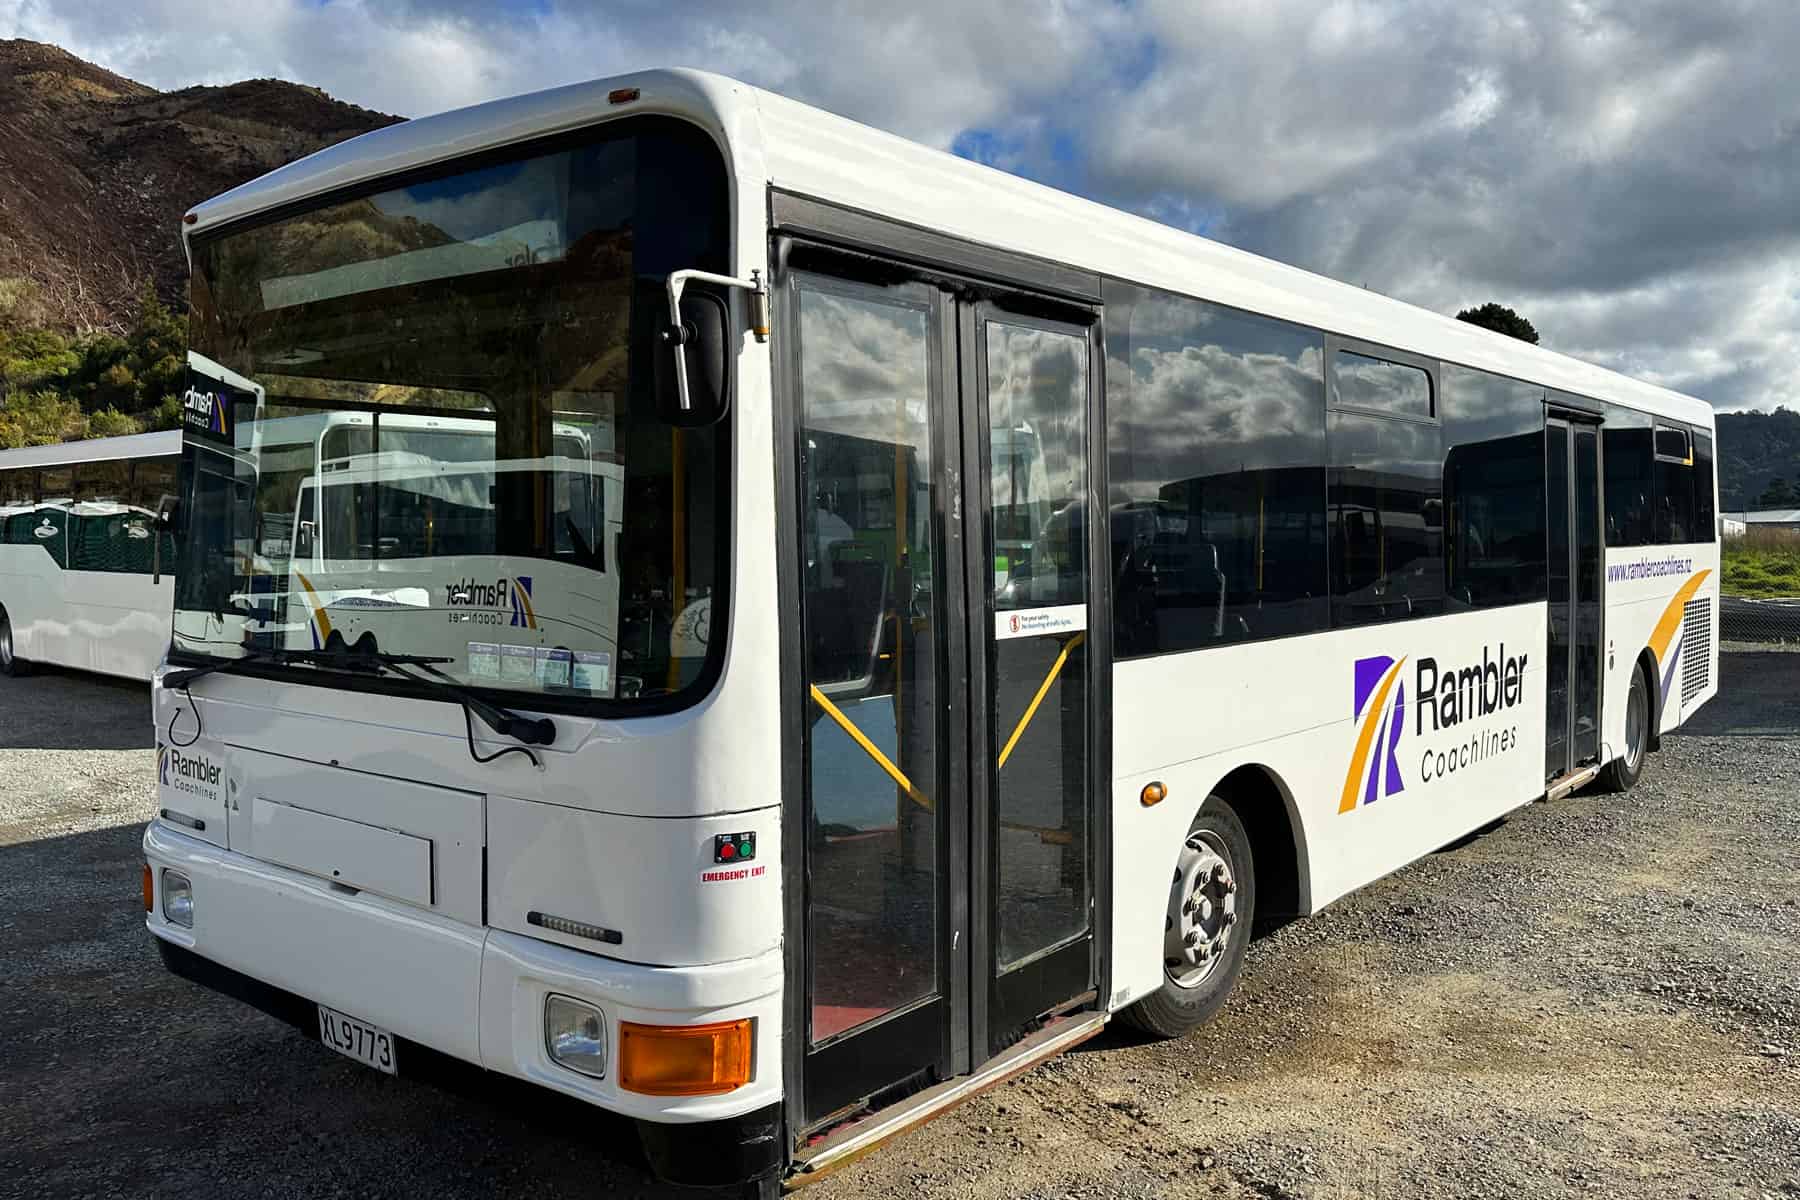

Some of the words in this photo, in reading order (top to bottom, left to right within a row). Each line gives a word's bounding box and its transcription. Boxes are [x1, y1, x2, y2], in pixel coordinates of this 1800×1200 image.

[1607, 555, 1692, 583] www.ramblercoachlines.nz
[1416, 643, 1528, 736] Rambler
[171, 748, 222, 786] Rambler
[1421, 725, 1518, 783] Coachlines
[174, 778, 217, 801] Coachlines
[702, 869, 749, 882] EMERGENCY
[751, 865, 766, 877] EXIT
[320, 1009, 391, 1067] XL9773
